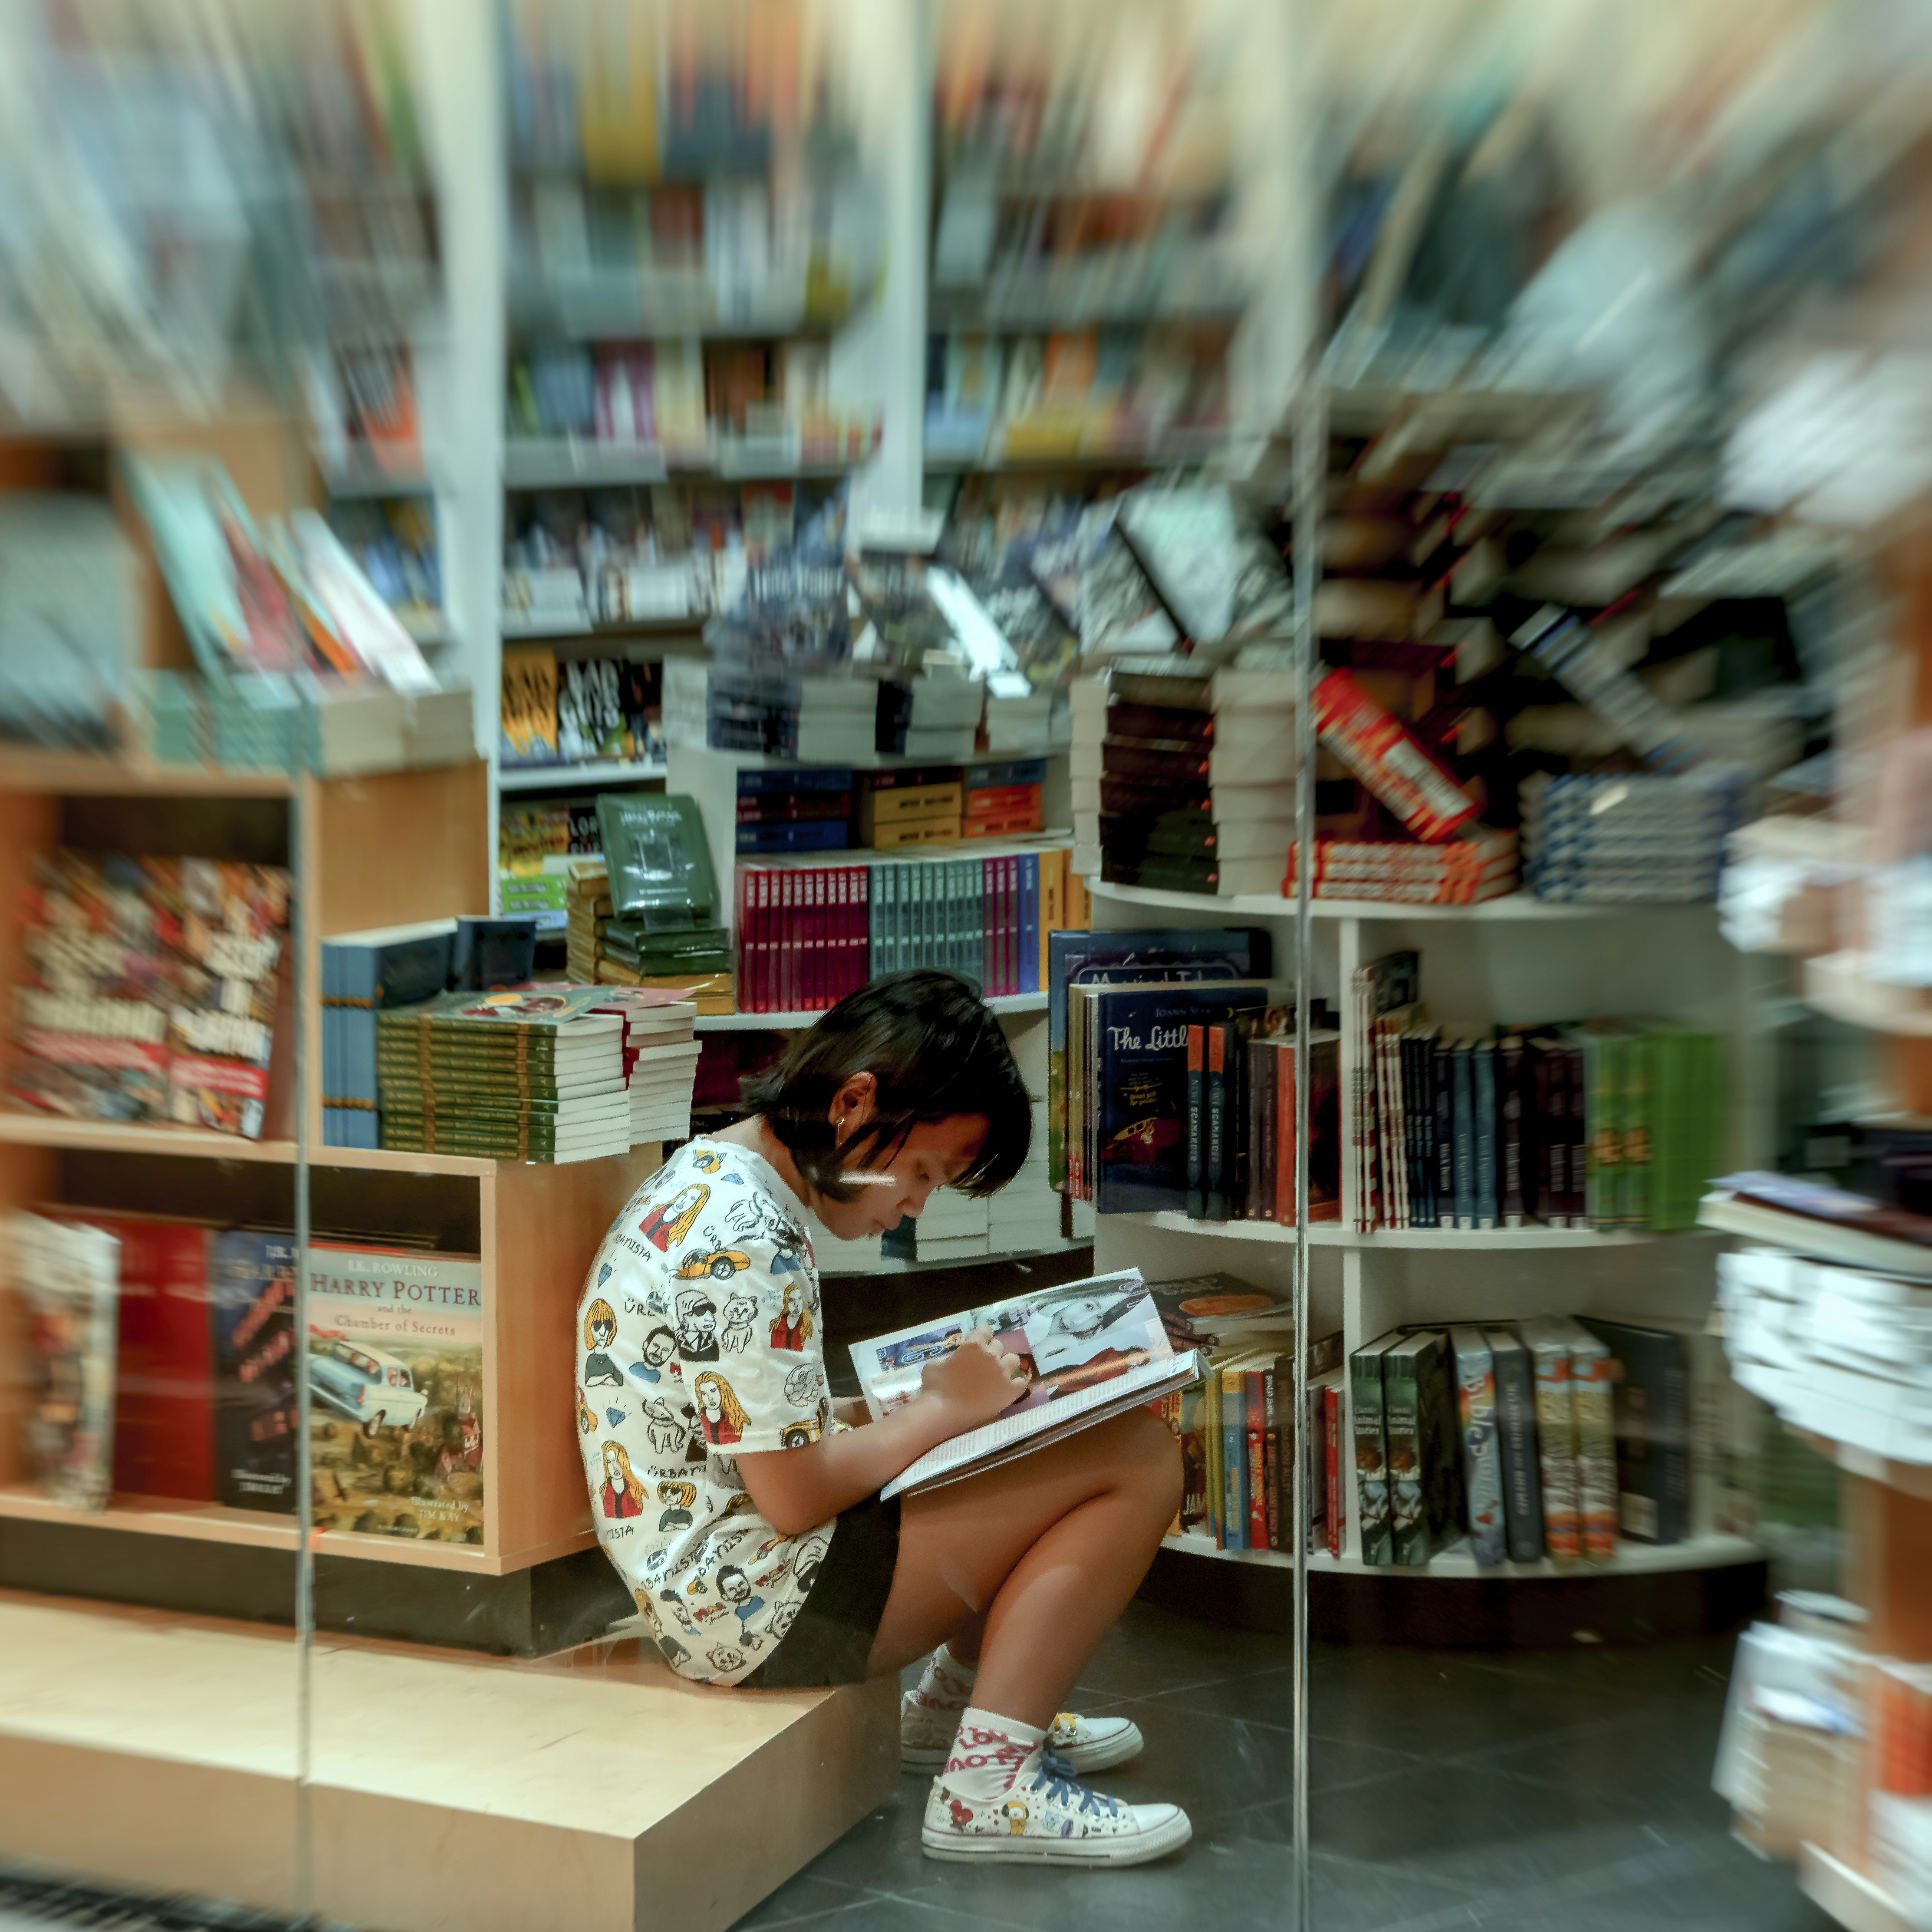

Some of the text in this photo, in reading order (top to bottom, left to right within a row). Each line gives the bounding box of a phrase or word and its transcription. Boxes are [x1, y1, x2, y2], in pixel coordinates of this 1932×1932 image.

[1107, 1025, 1188, 1051] The Littl
[373, 1262, 439, 1277] ROWLING
[310, 1272, 482, 1306] HARRY POTTER
[378, 1304, 412, 1315] and the
[334, 1314, 455, 1336] Chamber of Secrets
